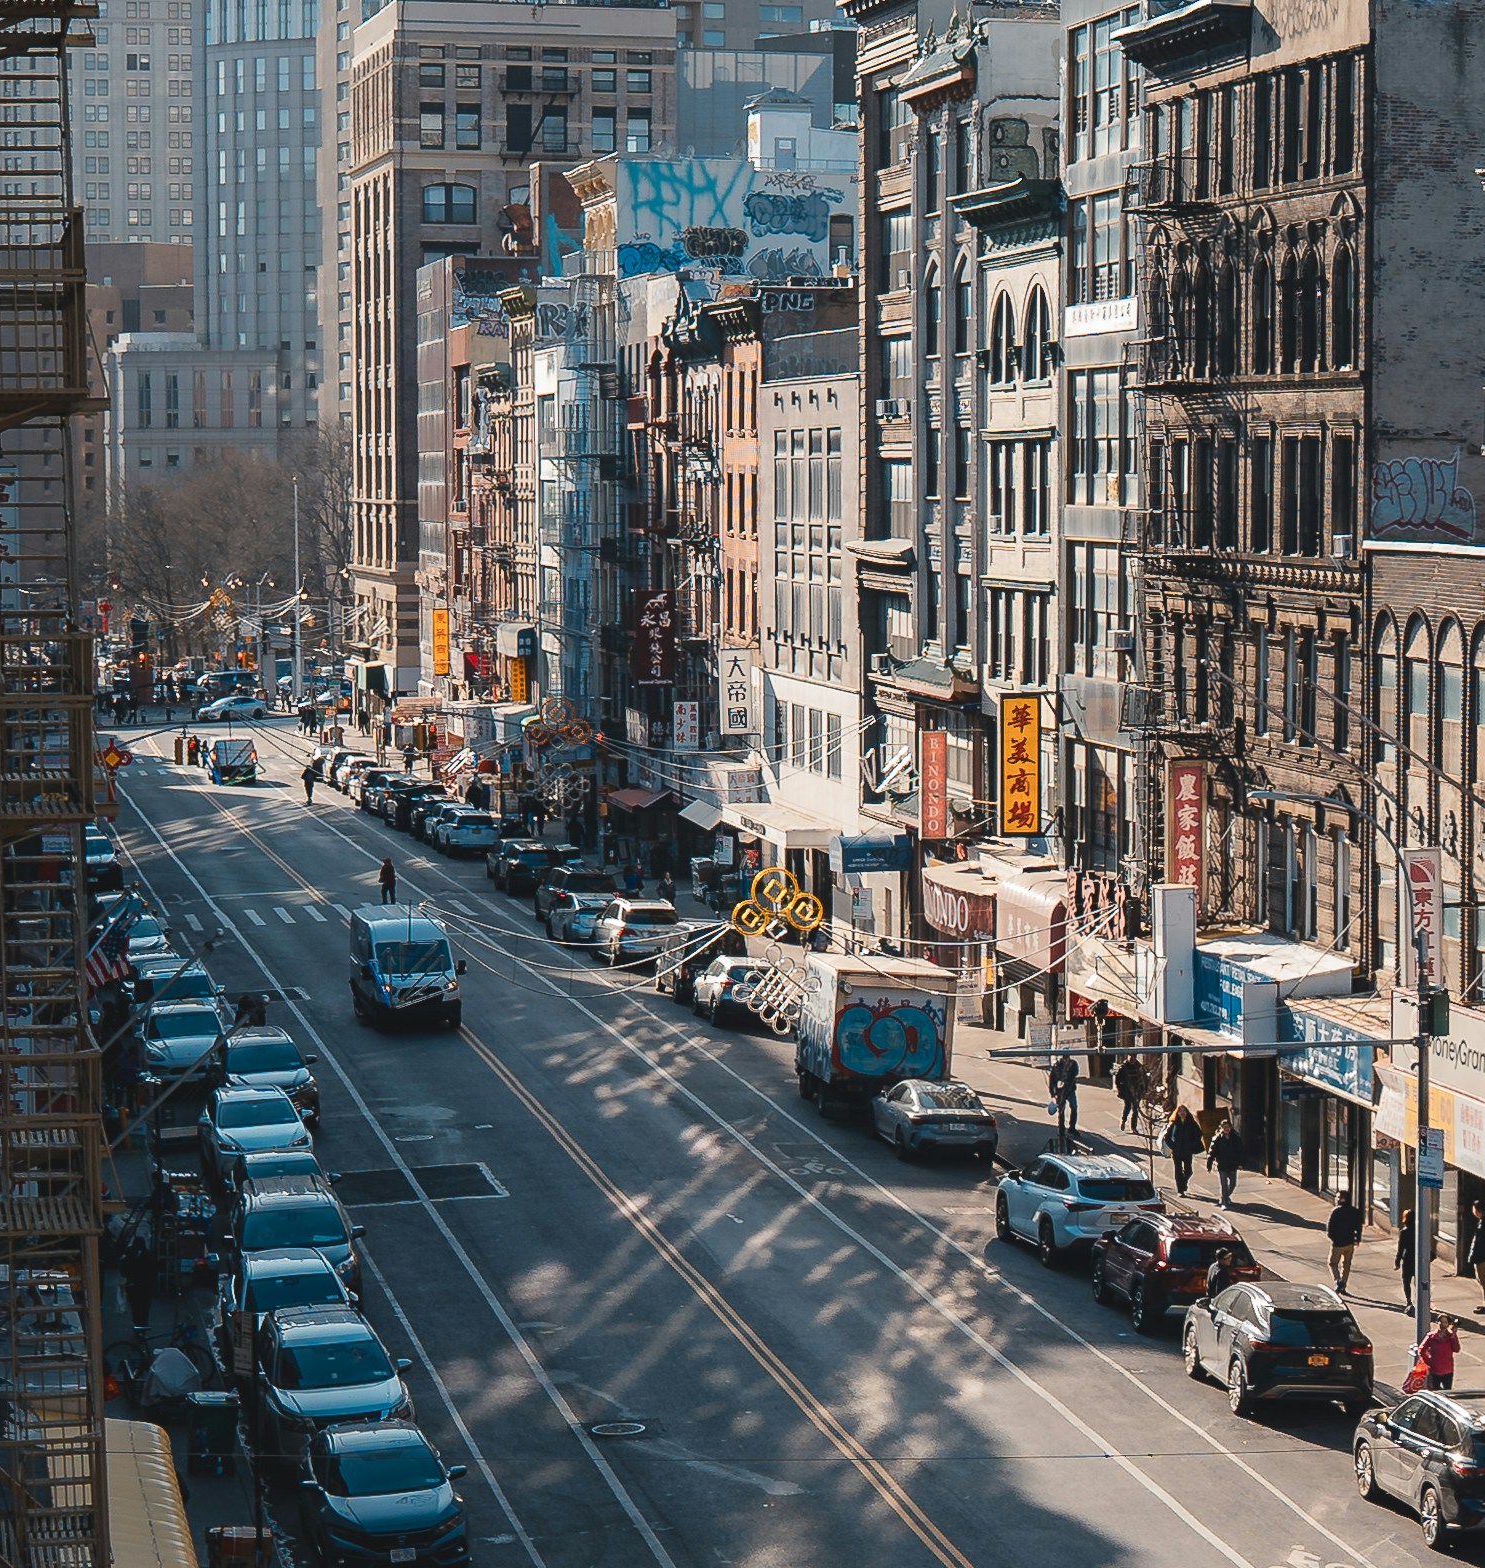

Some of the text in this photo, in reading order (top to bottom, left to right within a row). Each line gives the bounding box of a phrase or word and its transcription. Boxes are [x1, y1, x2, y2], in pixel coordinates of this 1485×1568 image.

[726, 655, 748, 729] 大帝國
[928, 737, 941, 833] BINONDO
[1007, 704, 1036, 830] 華美商場
